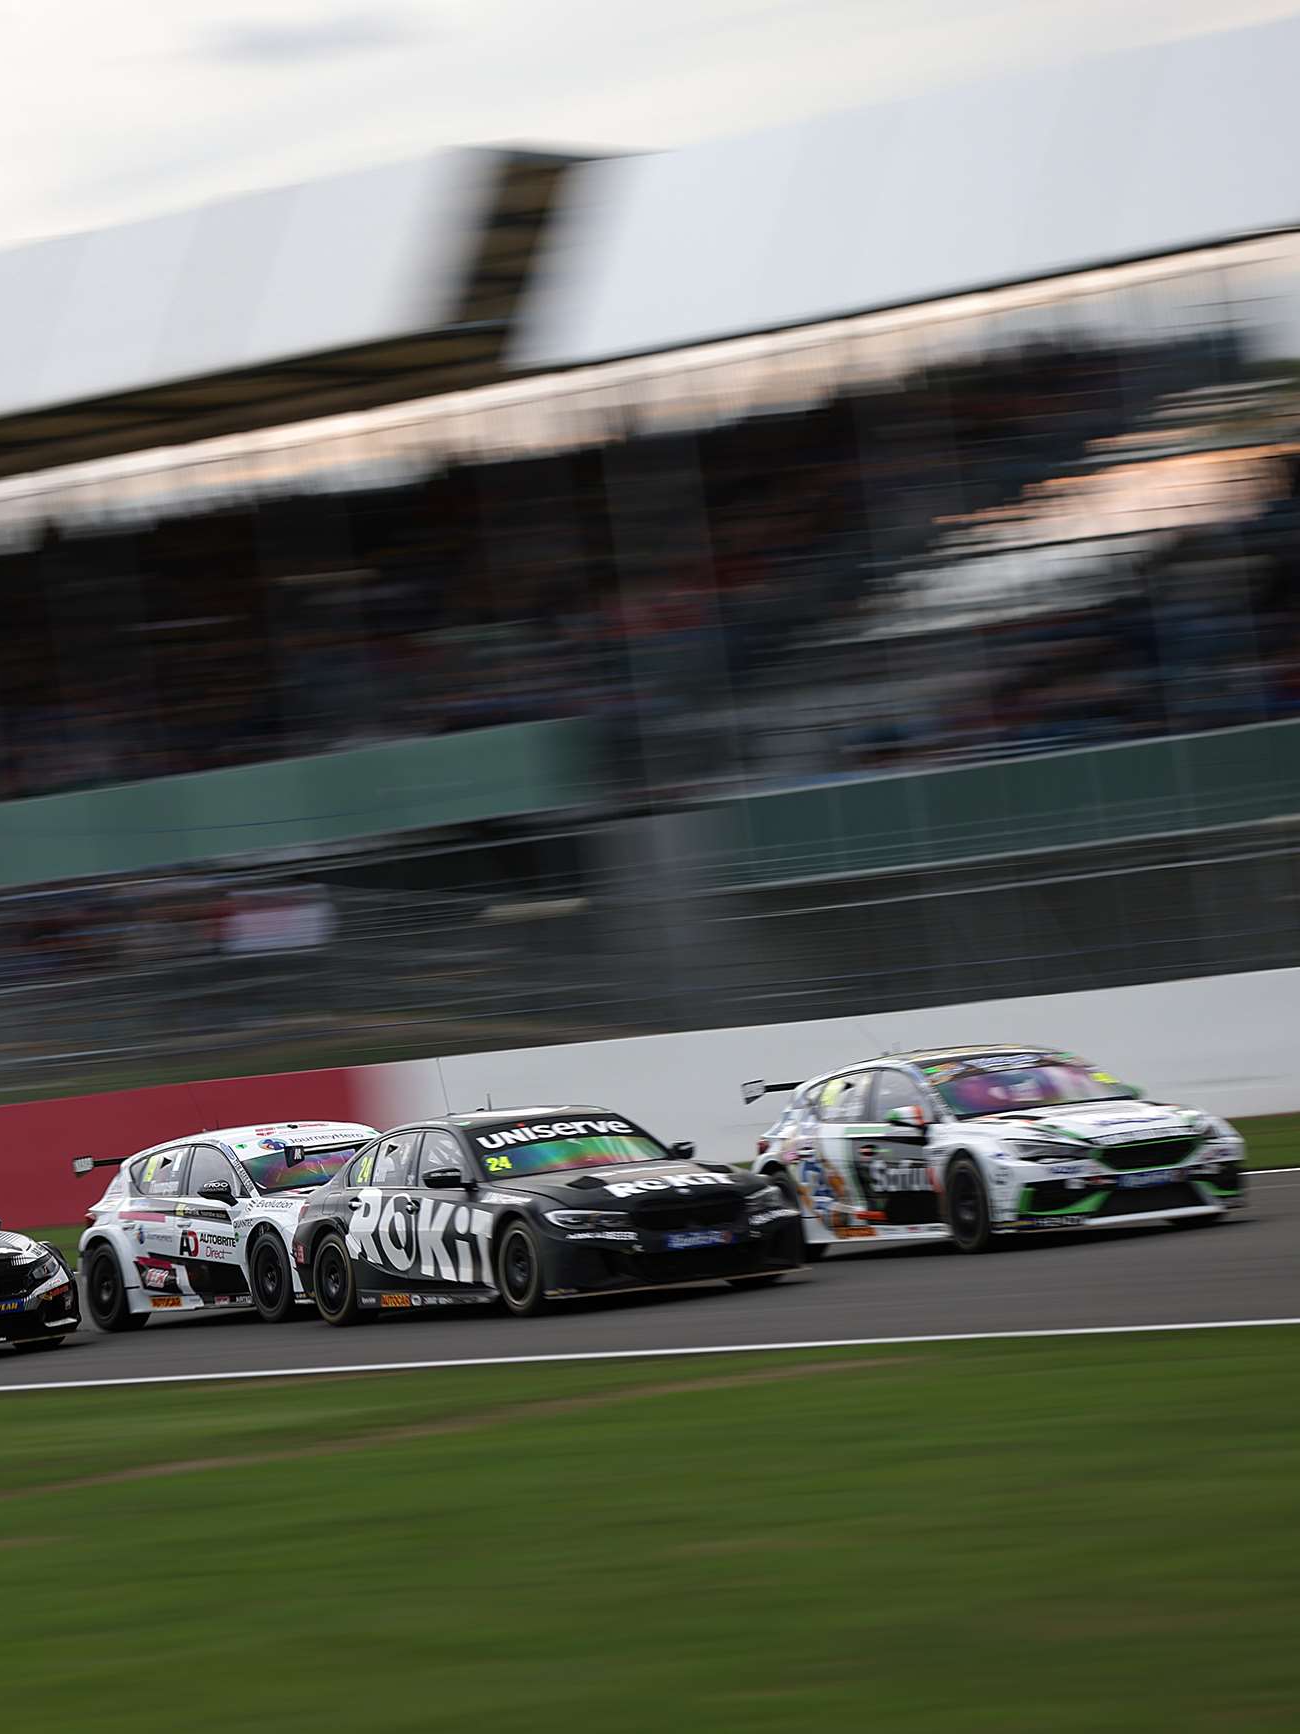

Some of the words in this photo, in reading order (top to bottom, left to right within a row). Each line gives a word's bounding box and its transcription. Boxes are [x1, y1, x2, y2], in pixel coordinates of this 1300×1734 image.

[356, 1156, 374, 1184] 24
[485, 1156, 512, 1172] 24
[256, 1200, 293, 1209] Evolution
[200, 1232, 236, 1248] AUTOBRITE
[205, 1246, 227, 1259] Direct
